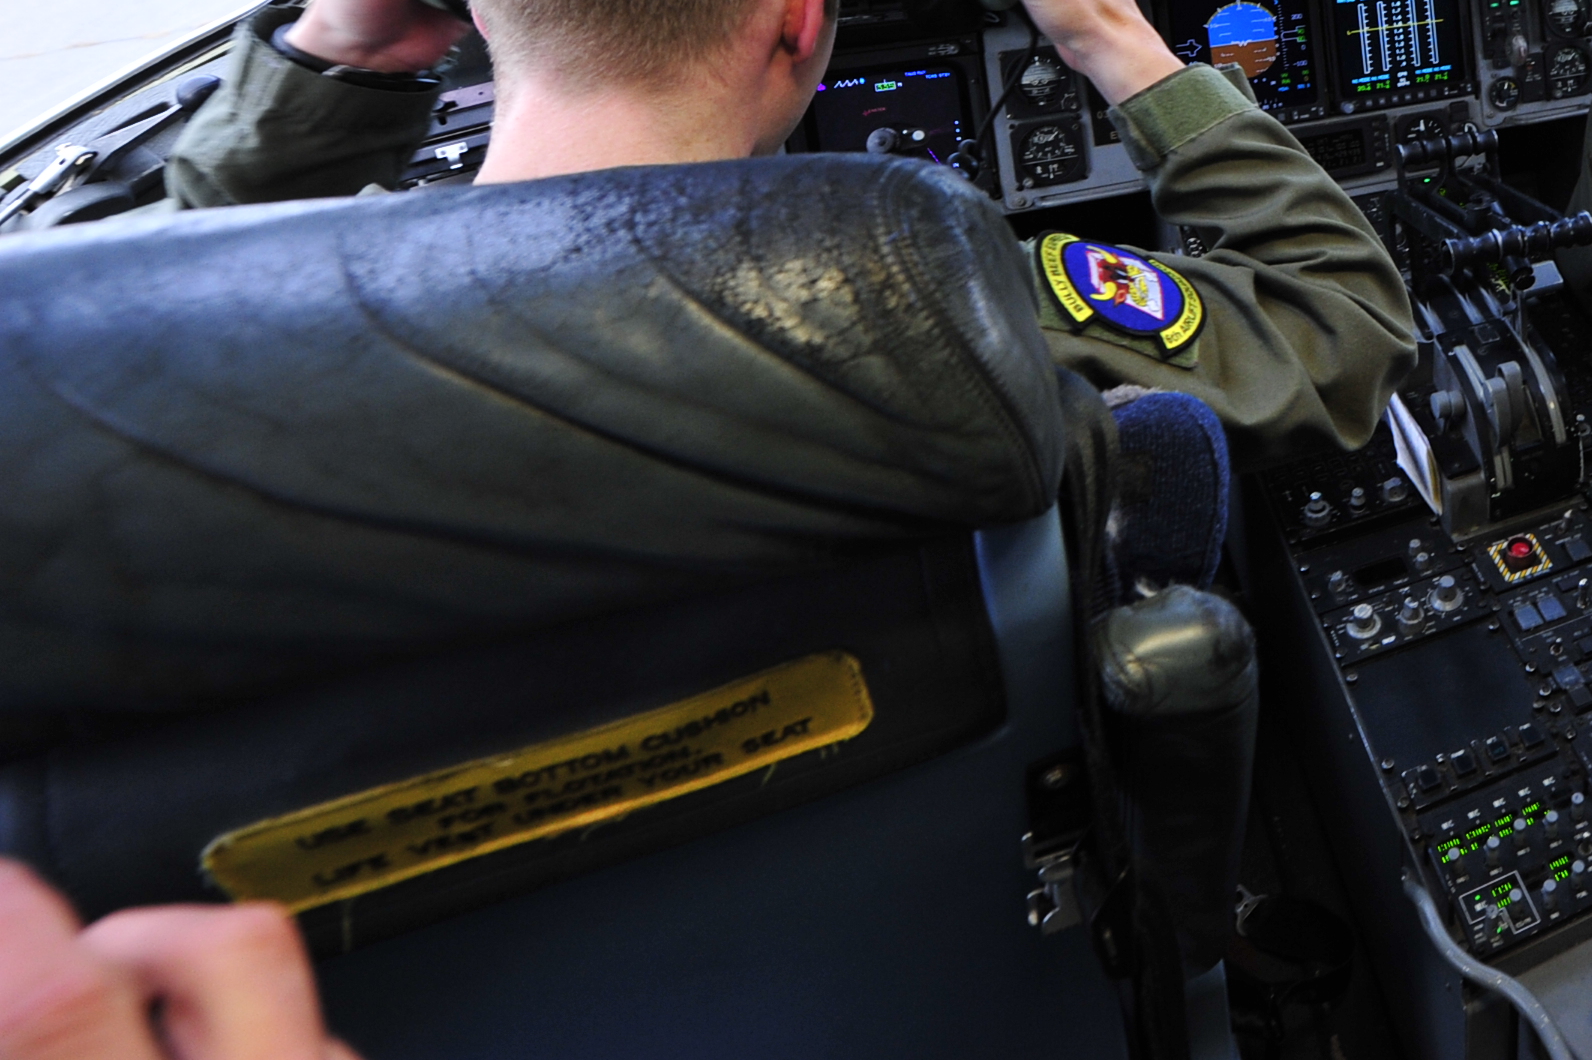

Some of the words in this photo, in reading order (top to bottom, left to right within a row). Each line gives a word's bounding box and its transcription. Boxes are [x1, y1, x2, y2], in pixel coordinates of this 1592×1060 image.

[1053, 280, 1084, 314] BULLY
[313, 852, 389, 888] LIFE
[407, 821, 495, 855] VEST
[638, 751, 724, 788] YOUR
[742, 716, 813, 755] SEAT
[386, 786, 478, 826] SEAT
[493, 744, 630, 795] BOTTOM
[640, 689, 771, 752] CUSHION
